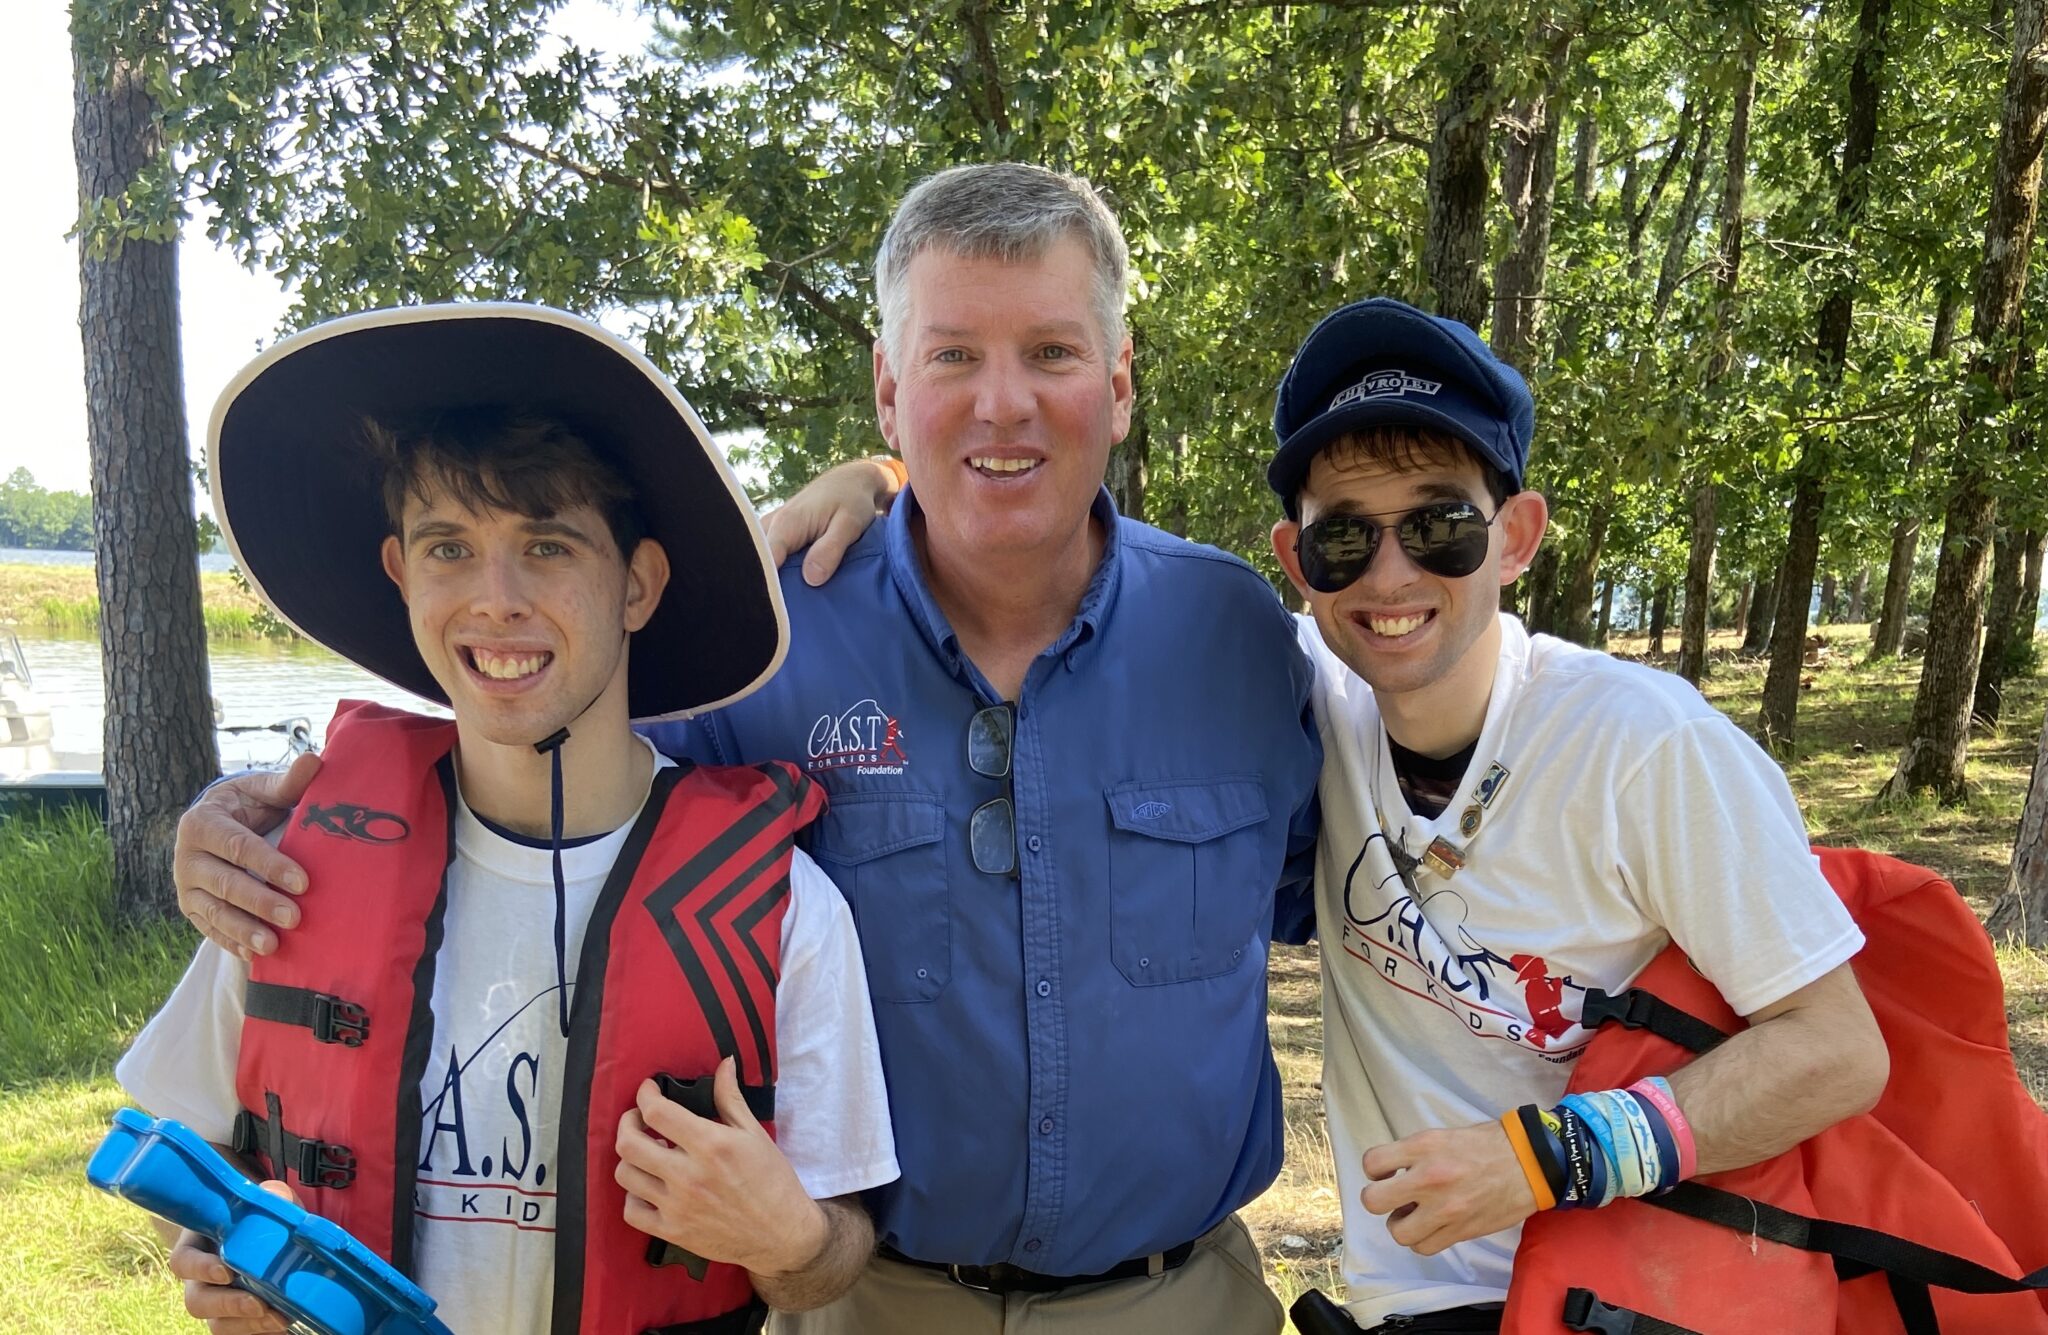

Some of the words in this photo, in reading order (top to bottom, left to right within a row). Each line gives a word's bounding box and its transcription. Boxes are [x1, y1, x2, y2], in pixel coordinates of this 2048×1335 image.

[1335, 377, 1435, 405] CHEVROLET
[808, 758, 832, 770] FOR
[840, 754, 878, 765] KIDS
[857, 765, 903, 775] Foundation
[1342, 924, 1397, 978] FOR
[461, 1193, 541, 1222] KID
